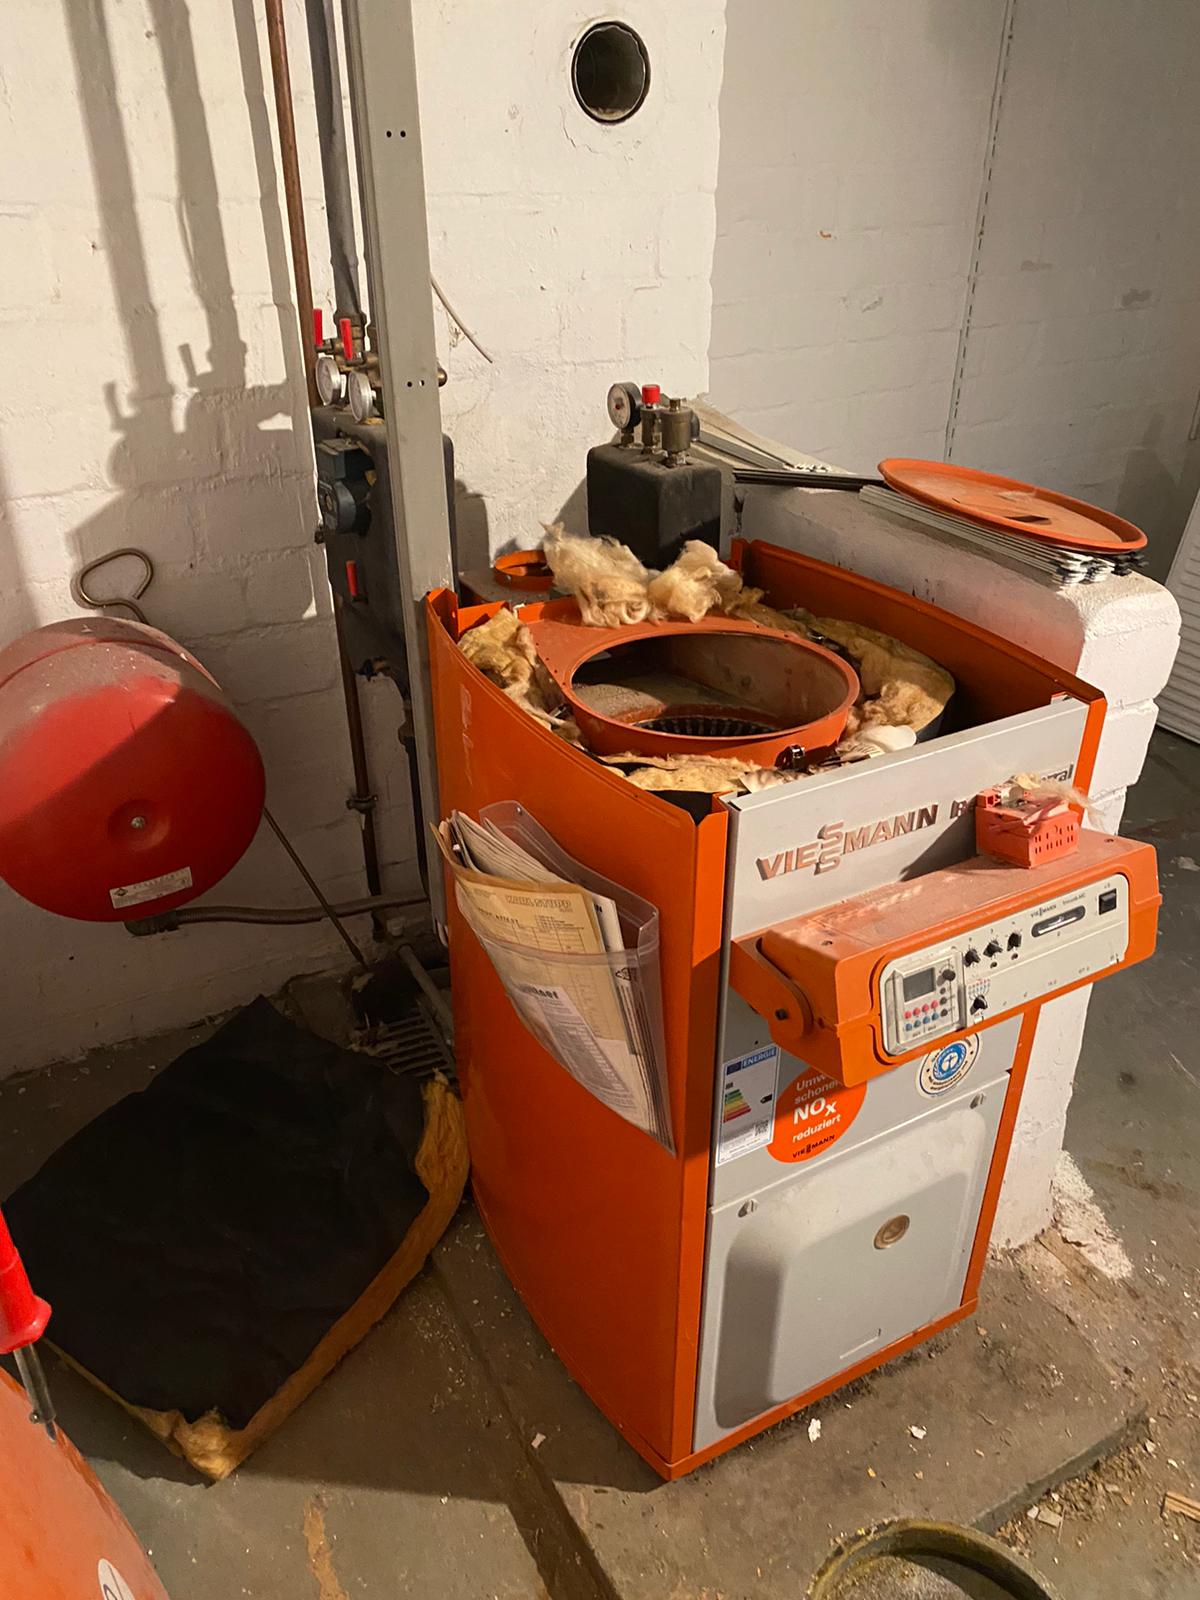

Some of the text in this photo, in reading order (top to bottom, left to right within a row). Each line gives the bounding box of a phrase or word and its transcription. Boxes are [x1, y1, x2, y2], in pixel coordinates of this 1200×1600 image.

[756, 803, 939, 880] VIESSMANN
[793, 1097, 837, 1125] NOx
[792, 1114, 841, 1144] reduziert
[792, 1134, 836, 1159] VIESSMANN
